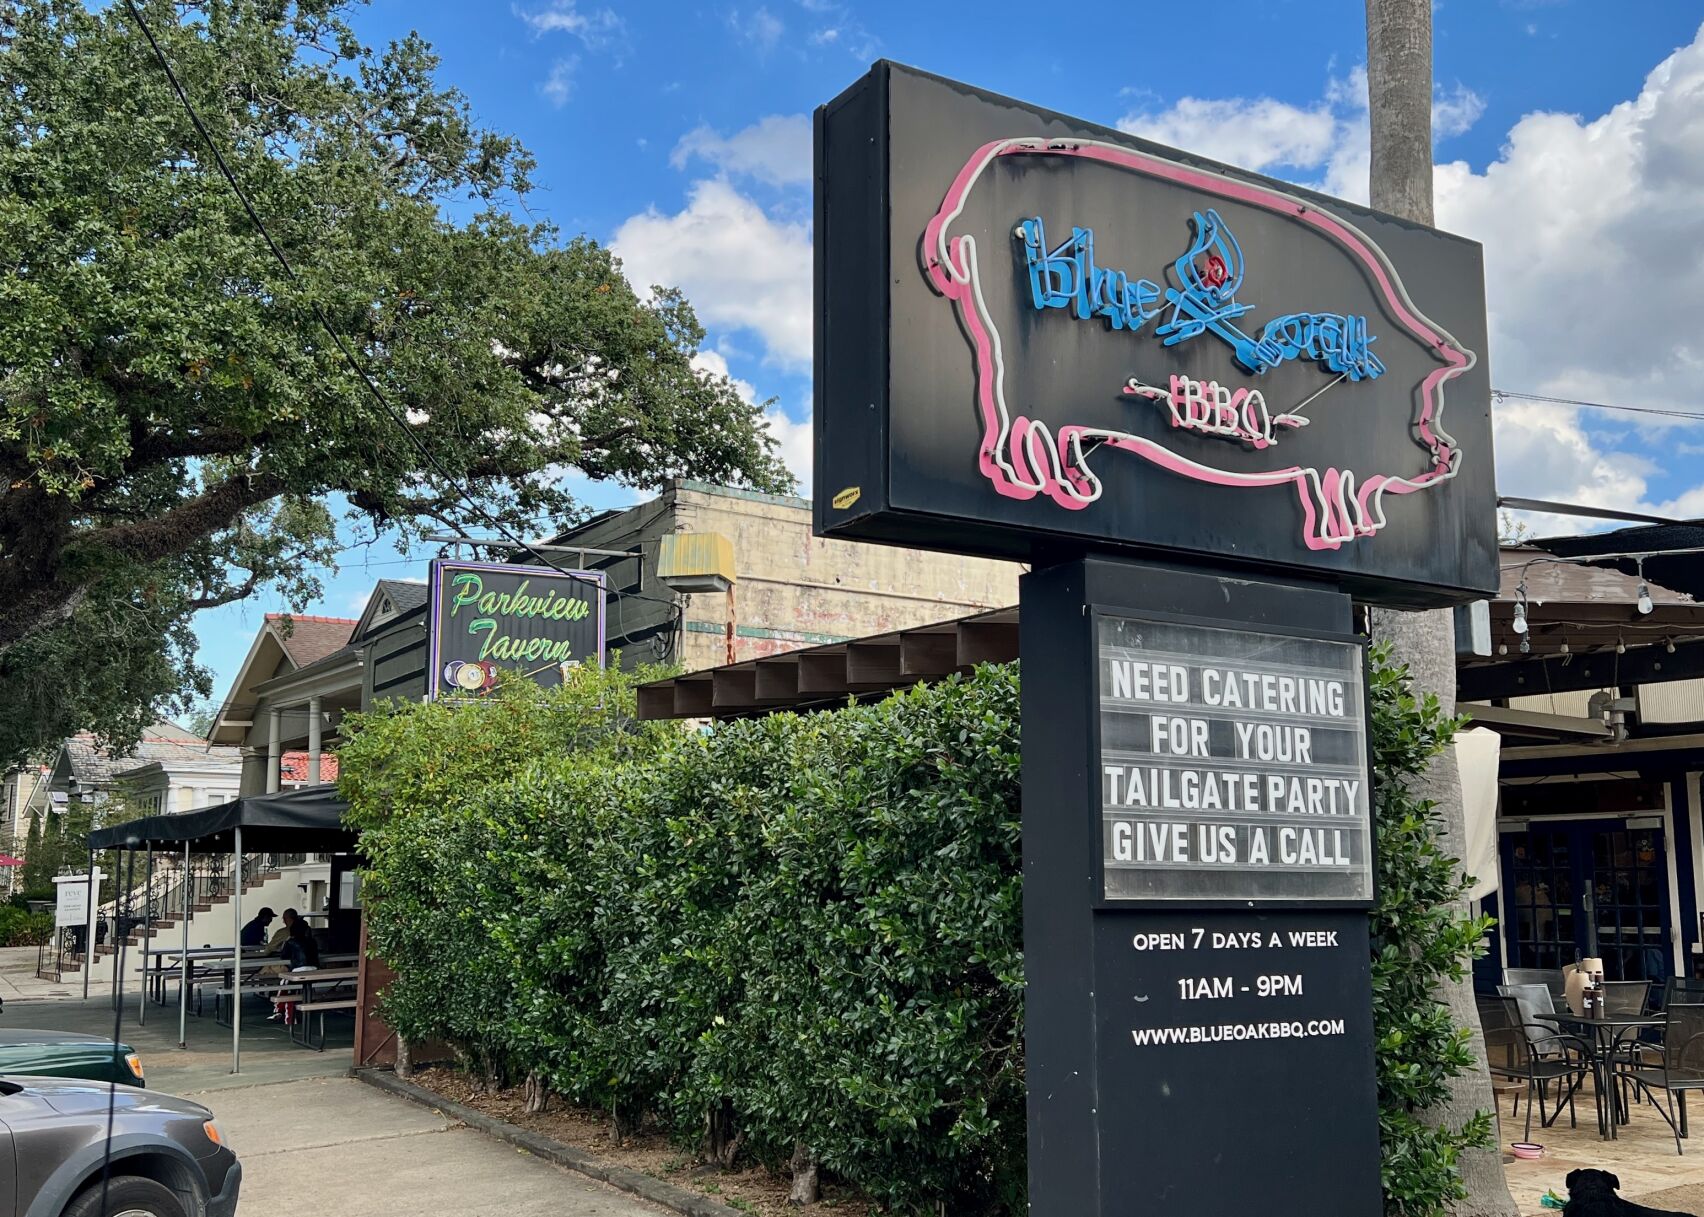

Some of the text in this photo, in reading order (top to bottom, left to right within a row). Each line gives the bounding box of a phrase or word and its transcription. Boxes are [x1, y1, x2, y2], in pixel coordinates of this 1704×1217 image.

[1168, 373, 1278, 450] BBQ
[451, 573, 590, 622] Parkview
[468, 618, 572, 663] Tavern
[1111, 660, 1344, 716] NEED CATERING
[1151, 715, 1312, 764] FOR YOUR
[1104, 766, 1360, 816] TAILGATE PARTY
[1112, 822, 1350, 866] GIVE US A CALL
[1133, 928, 1339, 950] OPEN 7 DAYS A WEEK
[1178, 977, 1233, 1000] 11AM
[1256, 974, 1303, 997] 9PM
[1132, 1019, 1345, 1046] WWW.BLUEOAKBBQ.COM
